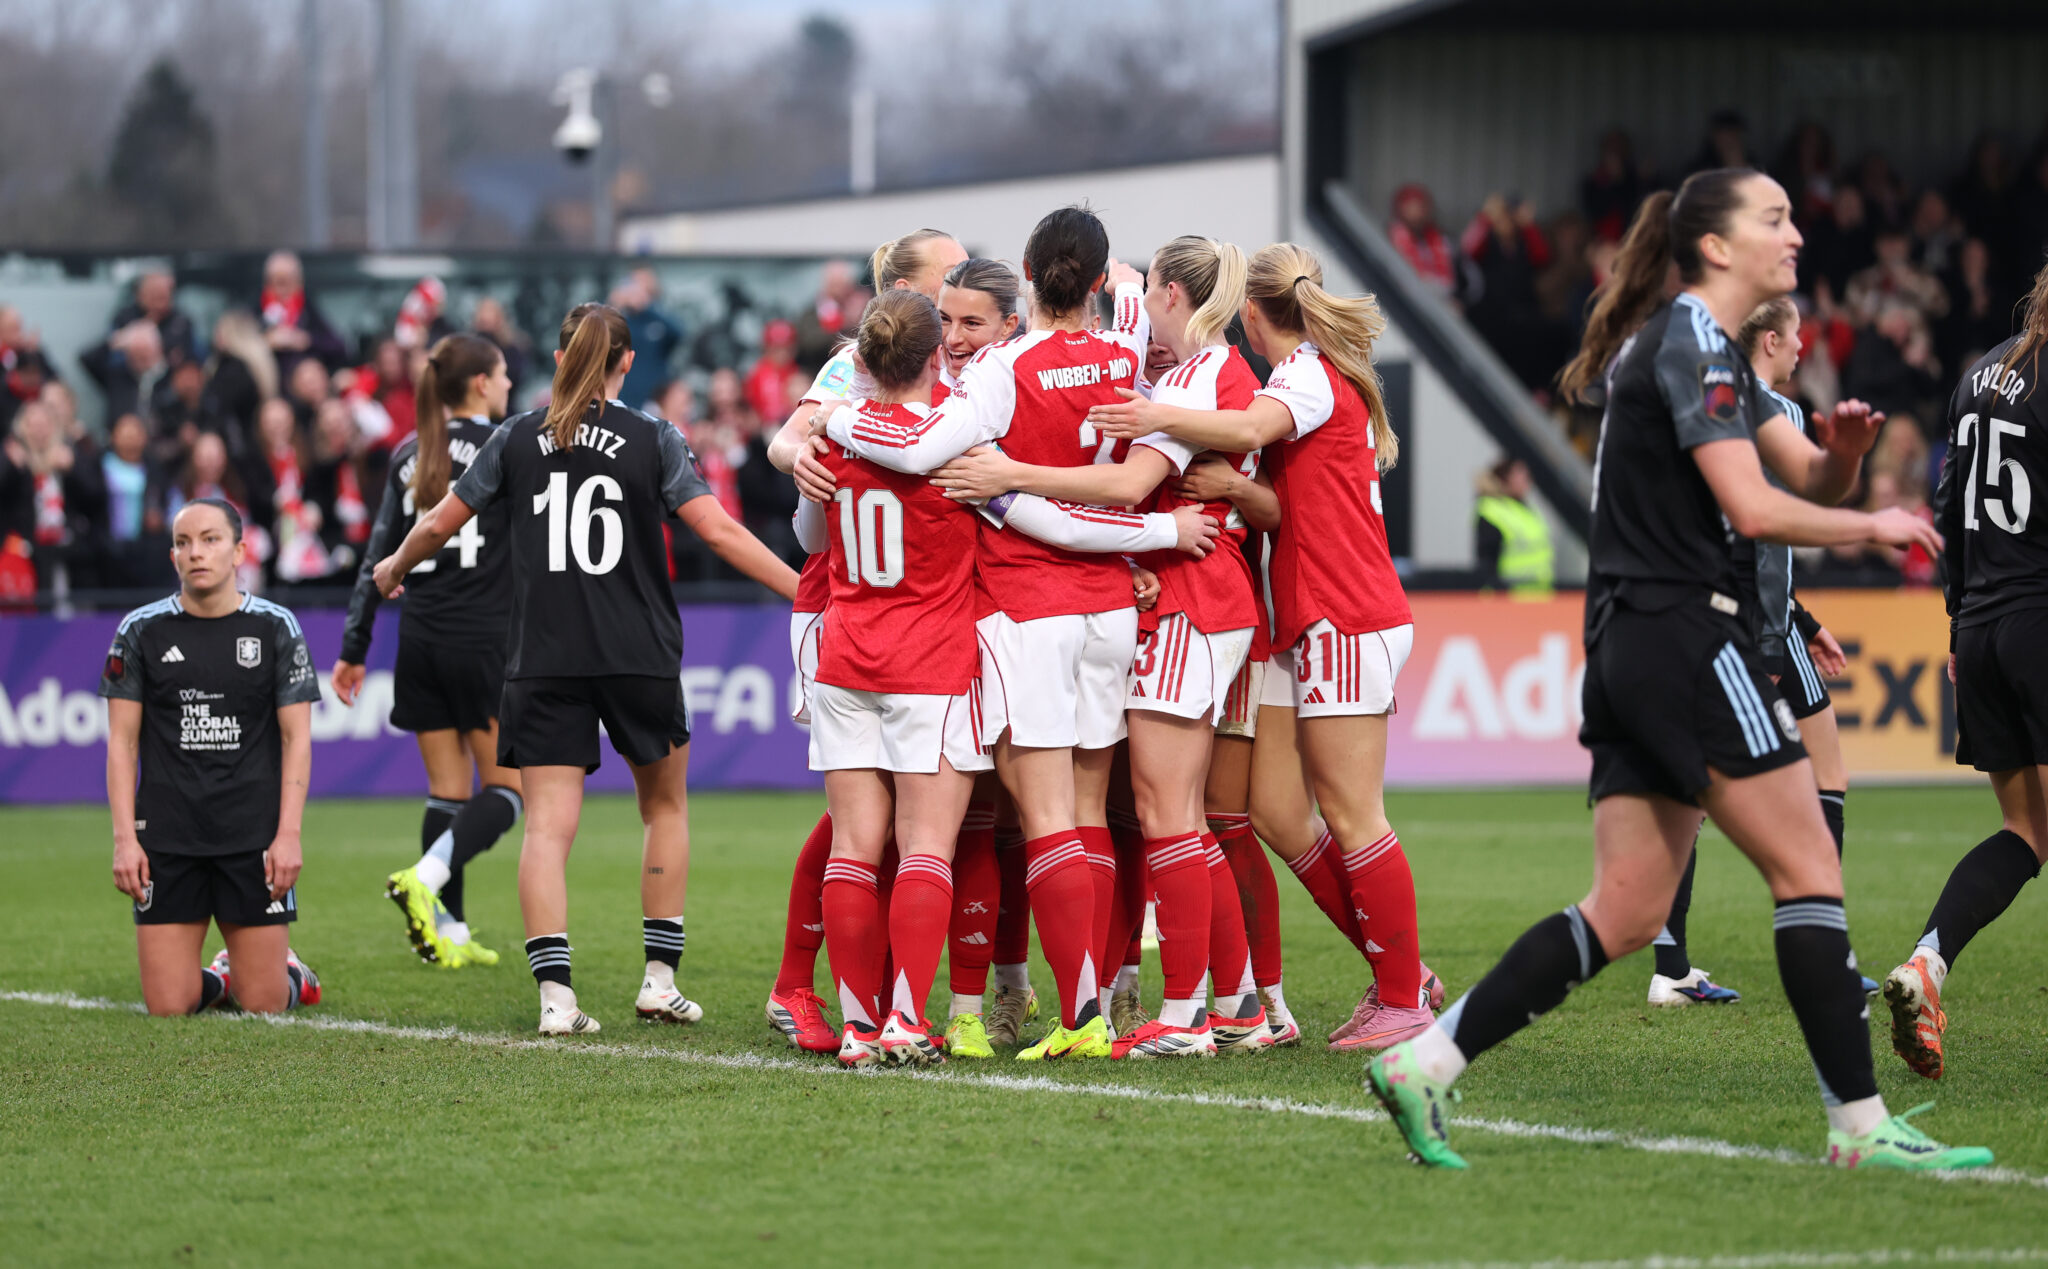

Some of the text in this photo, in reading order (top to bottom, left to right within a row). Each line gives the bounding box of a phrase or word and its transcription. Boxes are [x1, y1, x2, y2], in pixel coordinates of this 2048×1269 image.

[1036, 357, 1132, 391] WUBBEN-MOY
[1971, 362, 2025, 406] TAYLOR
[862, 406, 894, 418] Arsenal
[536, 423, 627, 460] MRITZ
[1957, 412, 2032, 535] 25
[532, 471, 624, 576] 16
[833, 486, 905, 589] 10
[1411, 632, 1586, 741] Ad
[180, 703, 211, 718] THE
[180, 715, 241, 731] GLOBAL
[180, 728, 242, 743] SUMMIT
